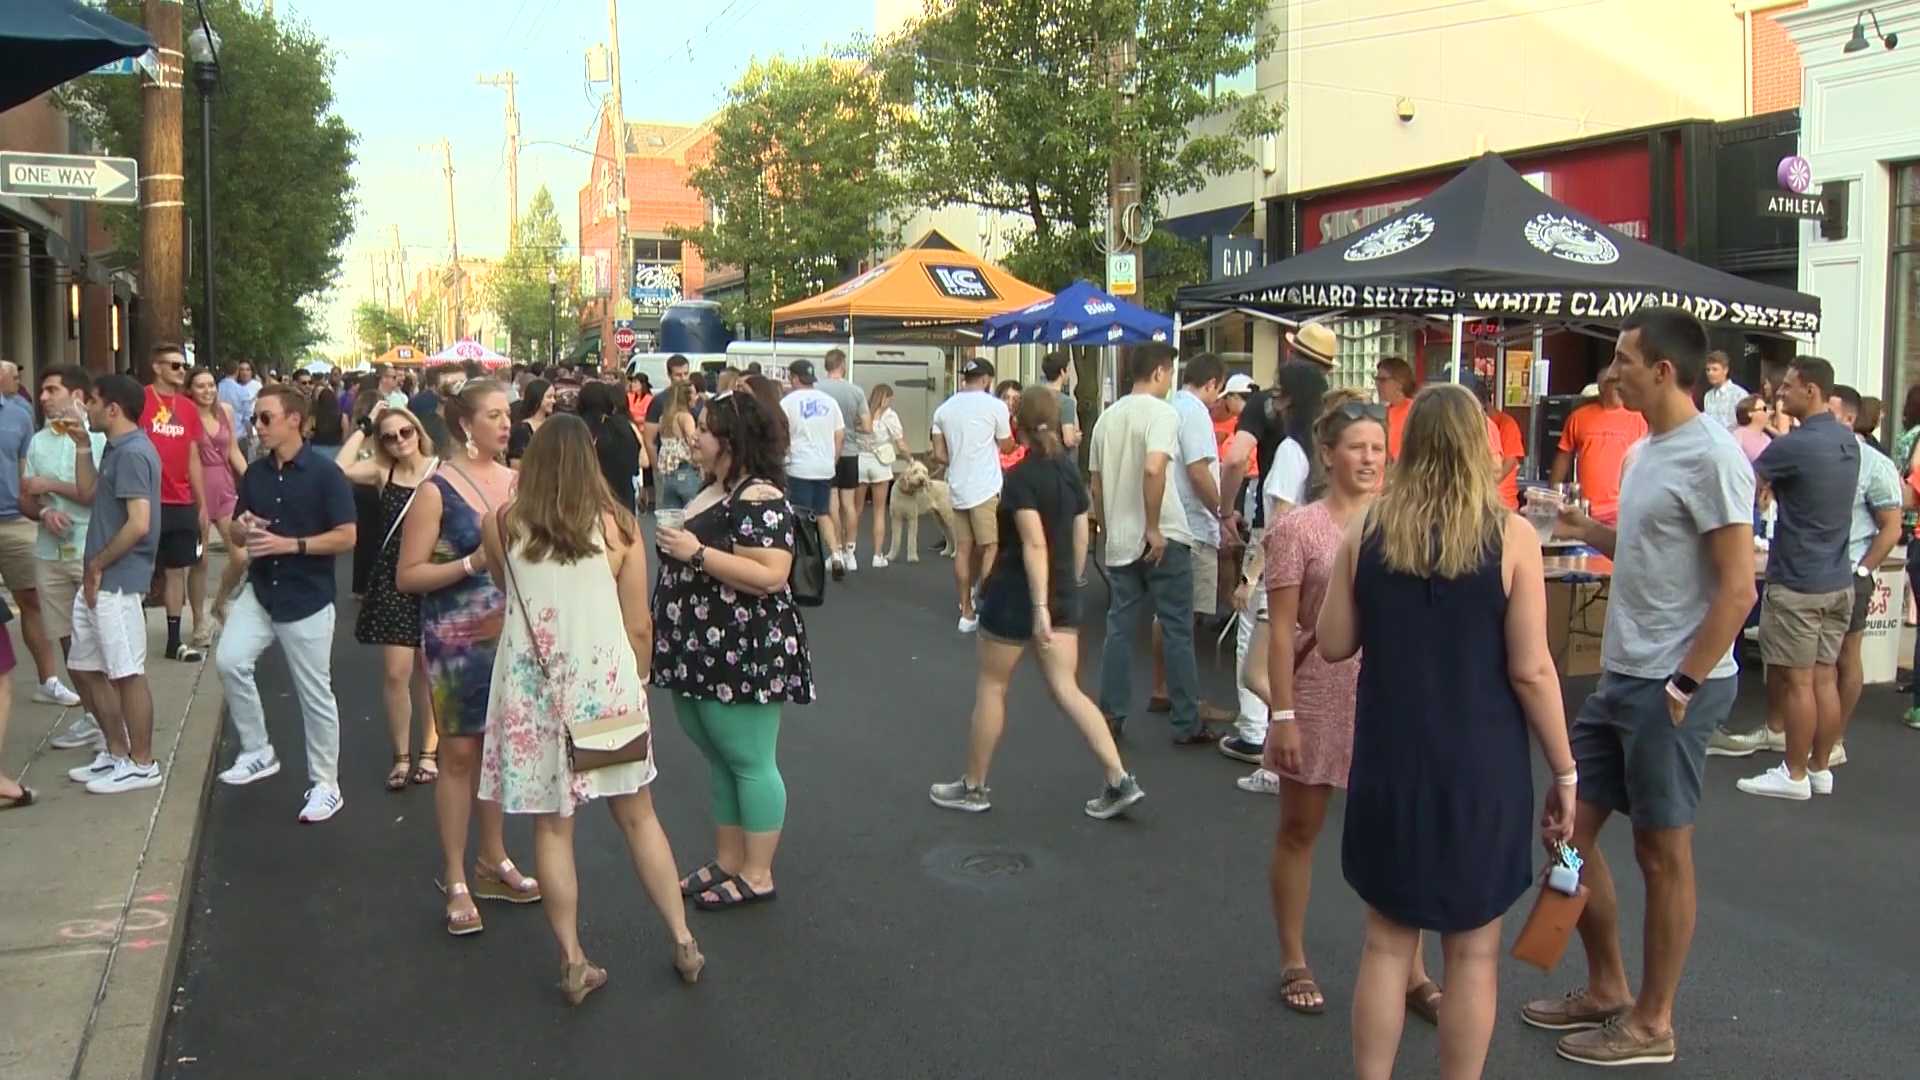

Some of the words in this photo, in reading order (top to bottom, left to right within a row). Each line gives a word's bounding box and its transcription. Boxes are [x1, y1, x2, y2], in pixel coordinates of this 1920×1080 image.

[15, 166, 50, 183] ONE
[57, 168, 96, 185] WAY
[1768, 197, 1825, 215] ATHLETA
[1223, 247, 1254, 277] GAP
[936, 268, 984, 289] IC
[947, 286, 987, 297] LIGHT
[1302, 284, 1357, 307] HARD
[1362, 286, 1456, 309] SELTZER
[1083, 302, 1116, 315] Blue
[1473, 292, 1563, 315] WHITE
[1570, 291, 1643, 317] CLAW
[1661, 292, 1727, 321] HARD
[1730, 302, 1819, 330] SELTZER
[616, 334, 634, 346] STOP
[1061, 327, 1079, 340] Blue
[152, 422, 184, 437] Kappa
